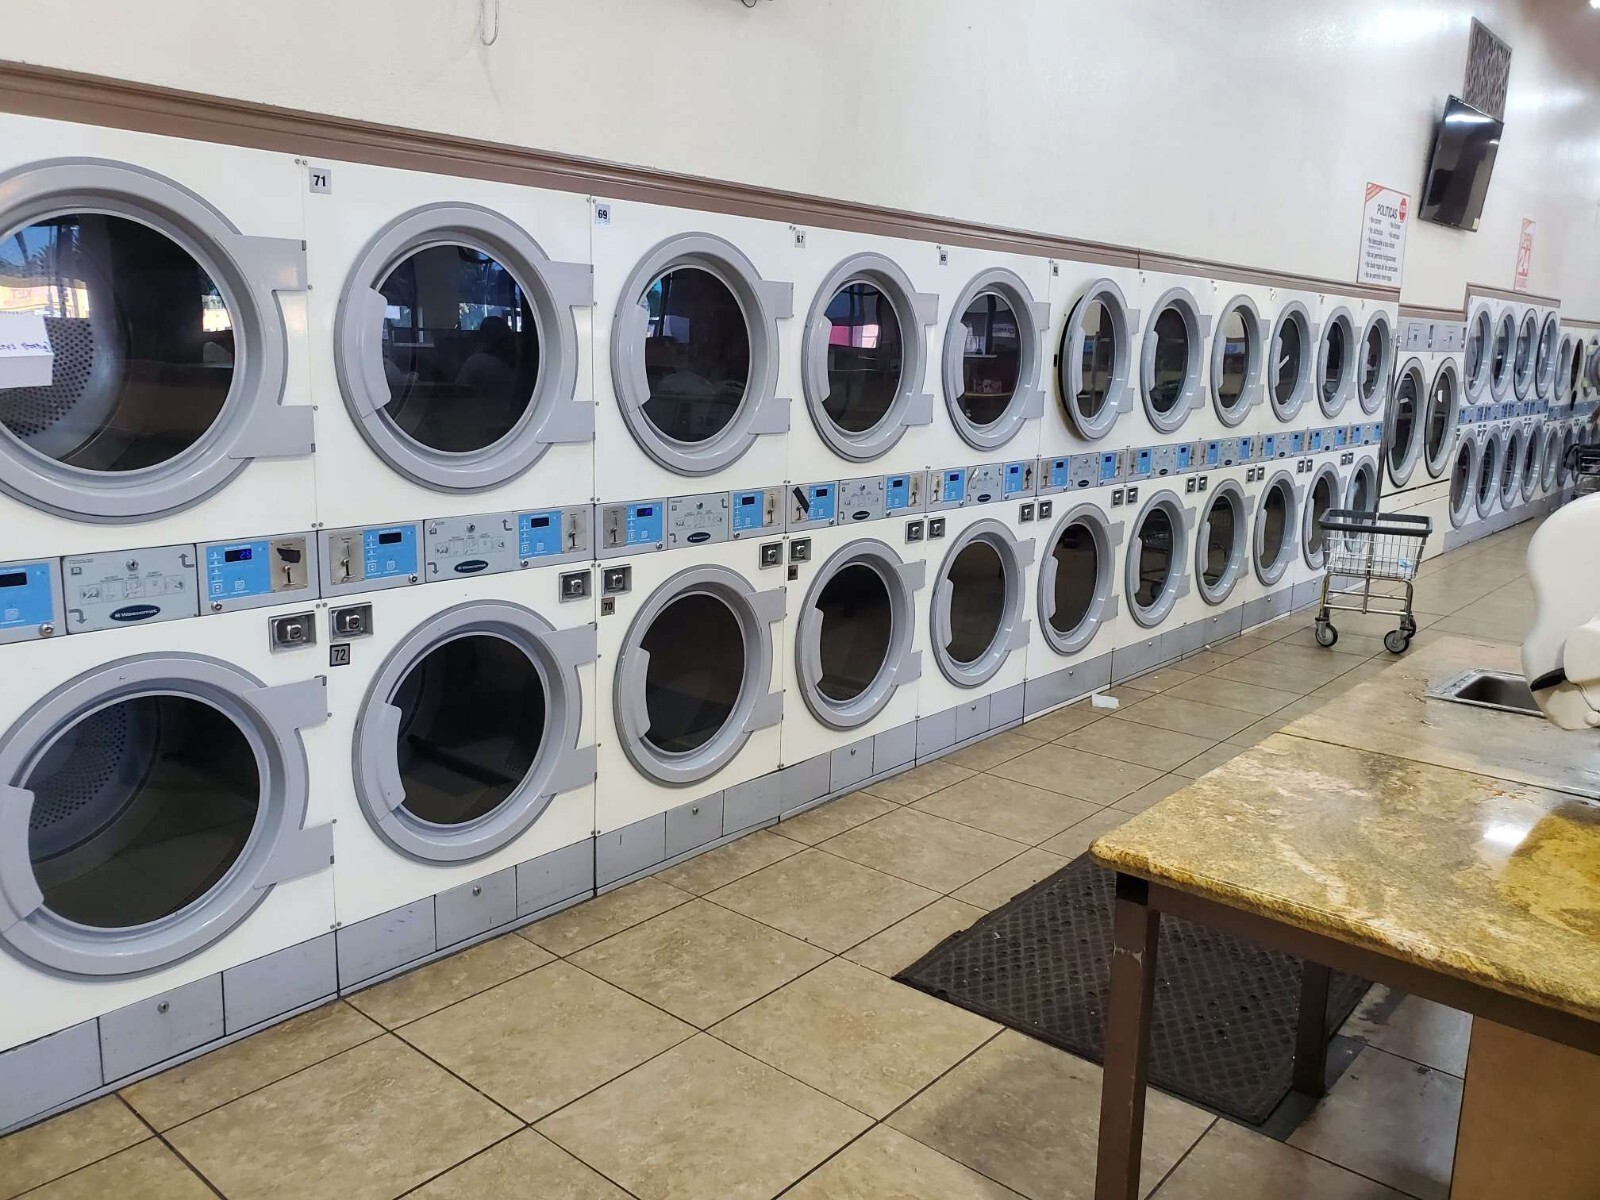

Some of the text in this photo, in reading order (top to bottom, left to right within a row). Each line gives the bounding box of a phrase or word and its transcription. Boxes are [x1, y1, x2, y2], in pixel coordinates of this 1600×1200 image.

[313, 174, 326, 187] 71
[598, 209, 608, 220] 69
[604, 601, 613, 611] 70
[334, 648, 346, 661] 72
